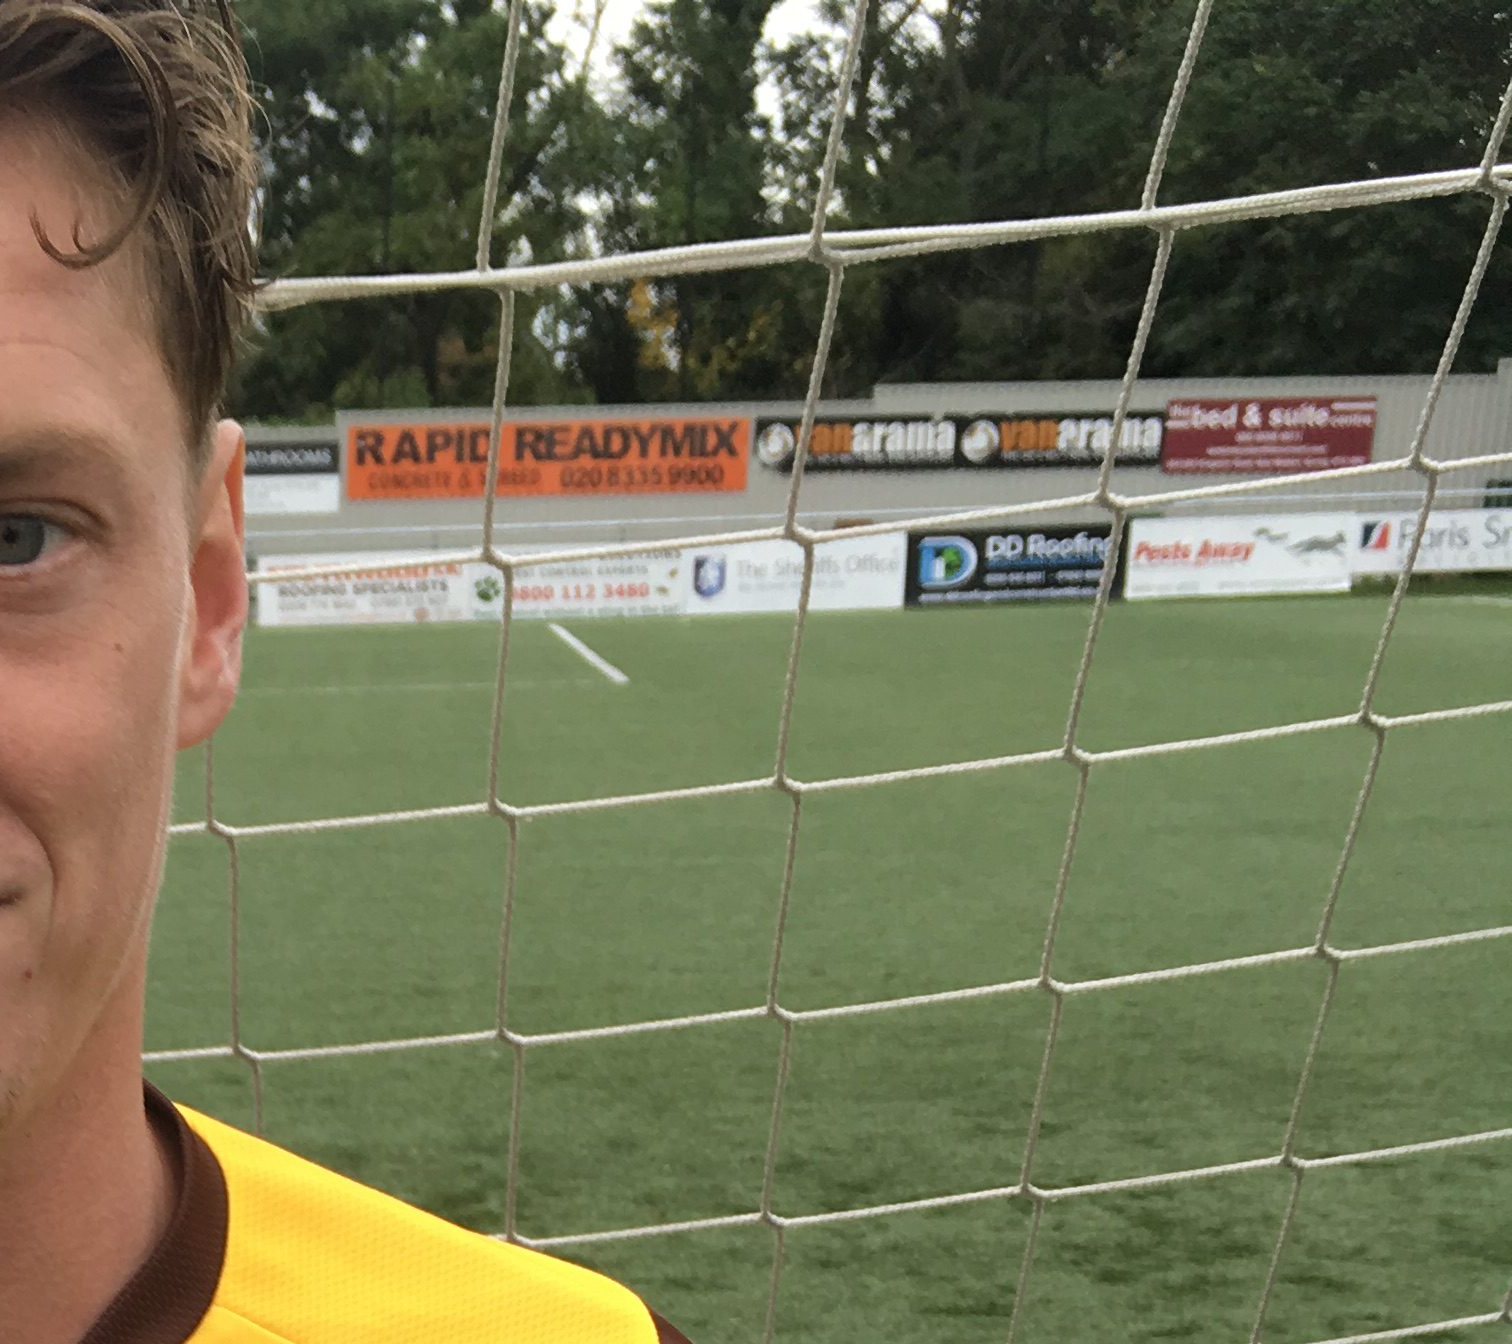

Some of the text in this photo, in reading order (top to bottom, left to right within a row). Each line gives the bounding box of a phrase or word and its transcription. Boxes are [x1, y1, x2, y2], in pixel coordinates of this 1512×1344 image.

[1190, 403, 1238, 429] bed
[354, 426, 491, 466] RAPID
[515, 421, 740, 462] READYMIX
